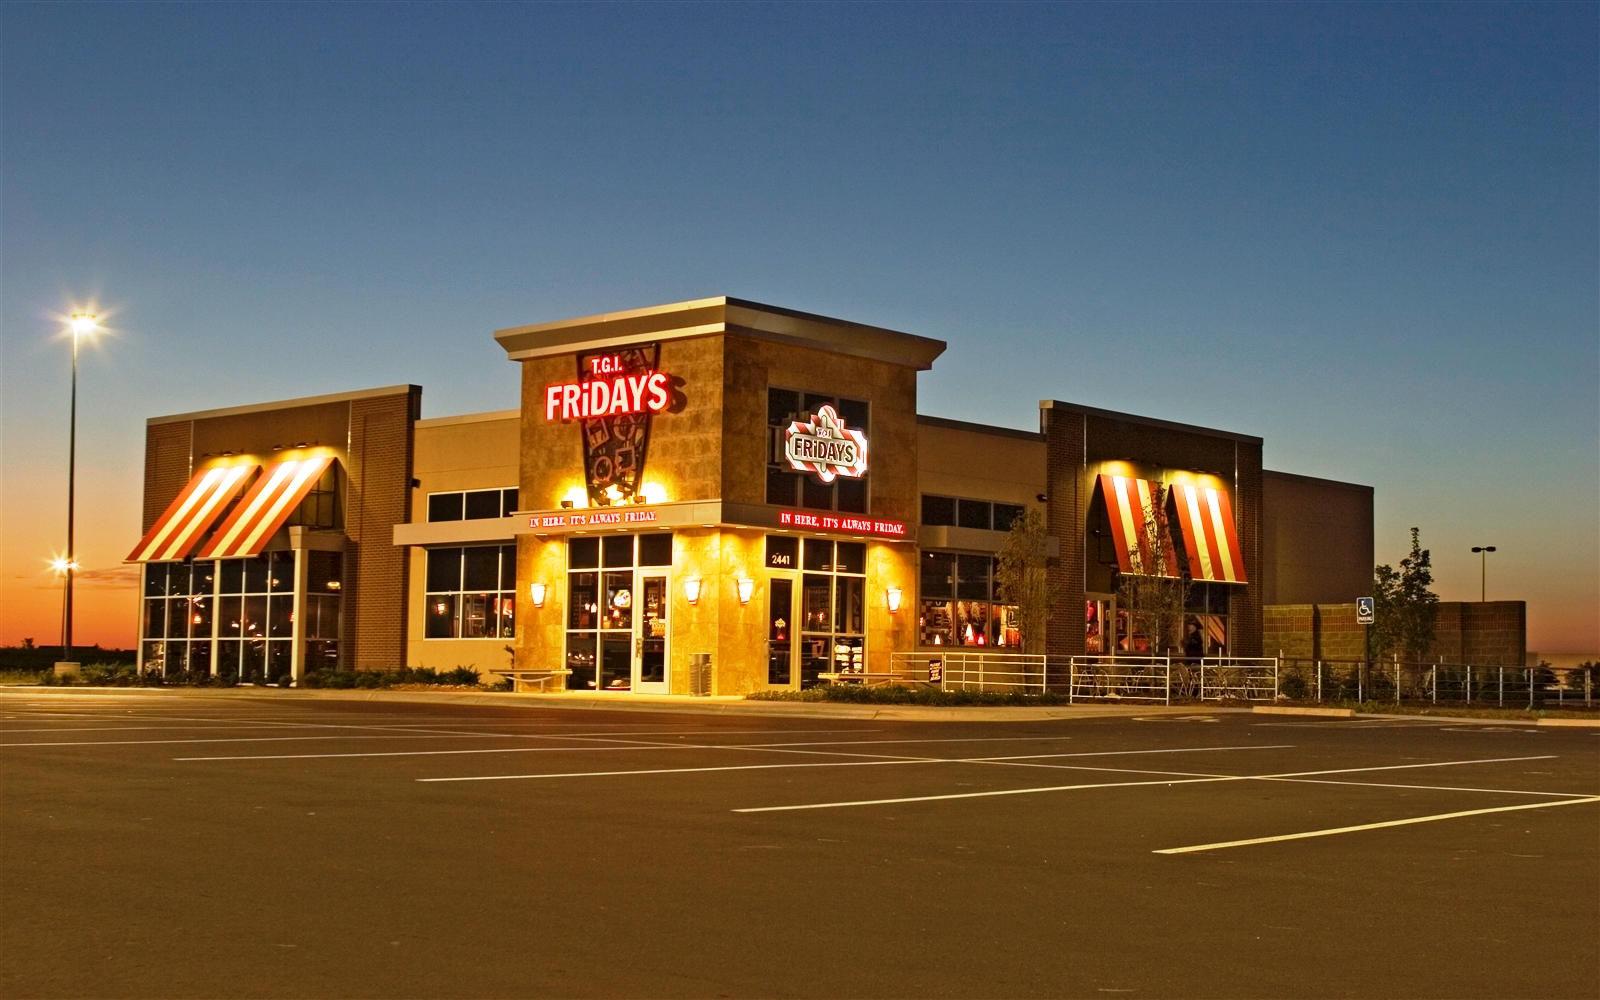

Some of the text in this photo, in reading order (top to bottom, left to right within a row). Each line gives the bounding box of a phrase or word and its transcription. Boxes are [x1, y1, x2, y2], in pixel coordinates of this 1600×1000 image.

[591, 356, 622, 374] T.G.I.
[530, 518, 539, 527] IN
[570, 515, 586, 525] IT'S
[589, 513, 620, 524] ALWAYS
[781, 513, 791, 523] IN
[823, 517, 839, 528] IT'S
[841, 519, 871, 531] ALWAYS
[874, 522, 904, 534] FRIDAY.
[772, 554, 790, 565] 2441
